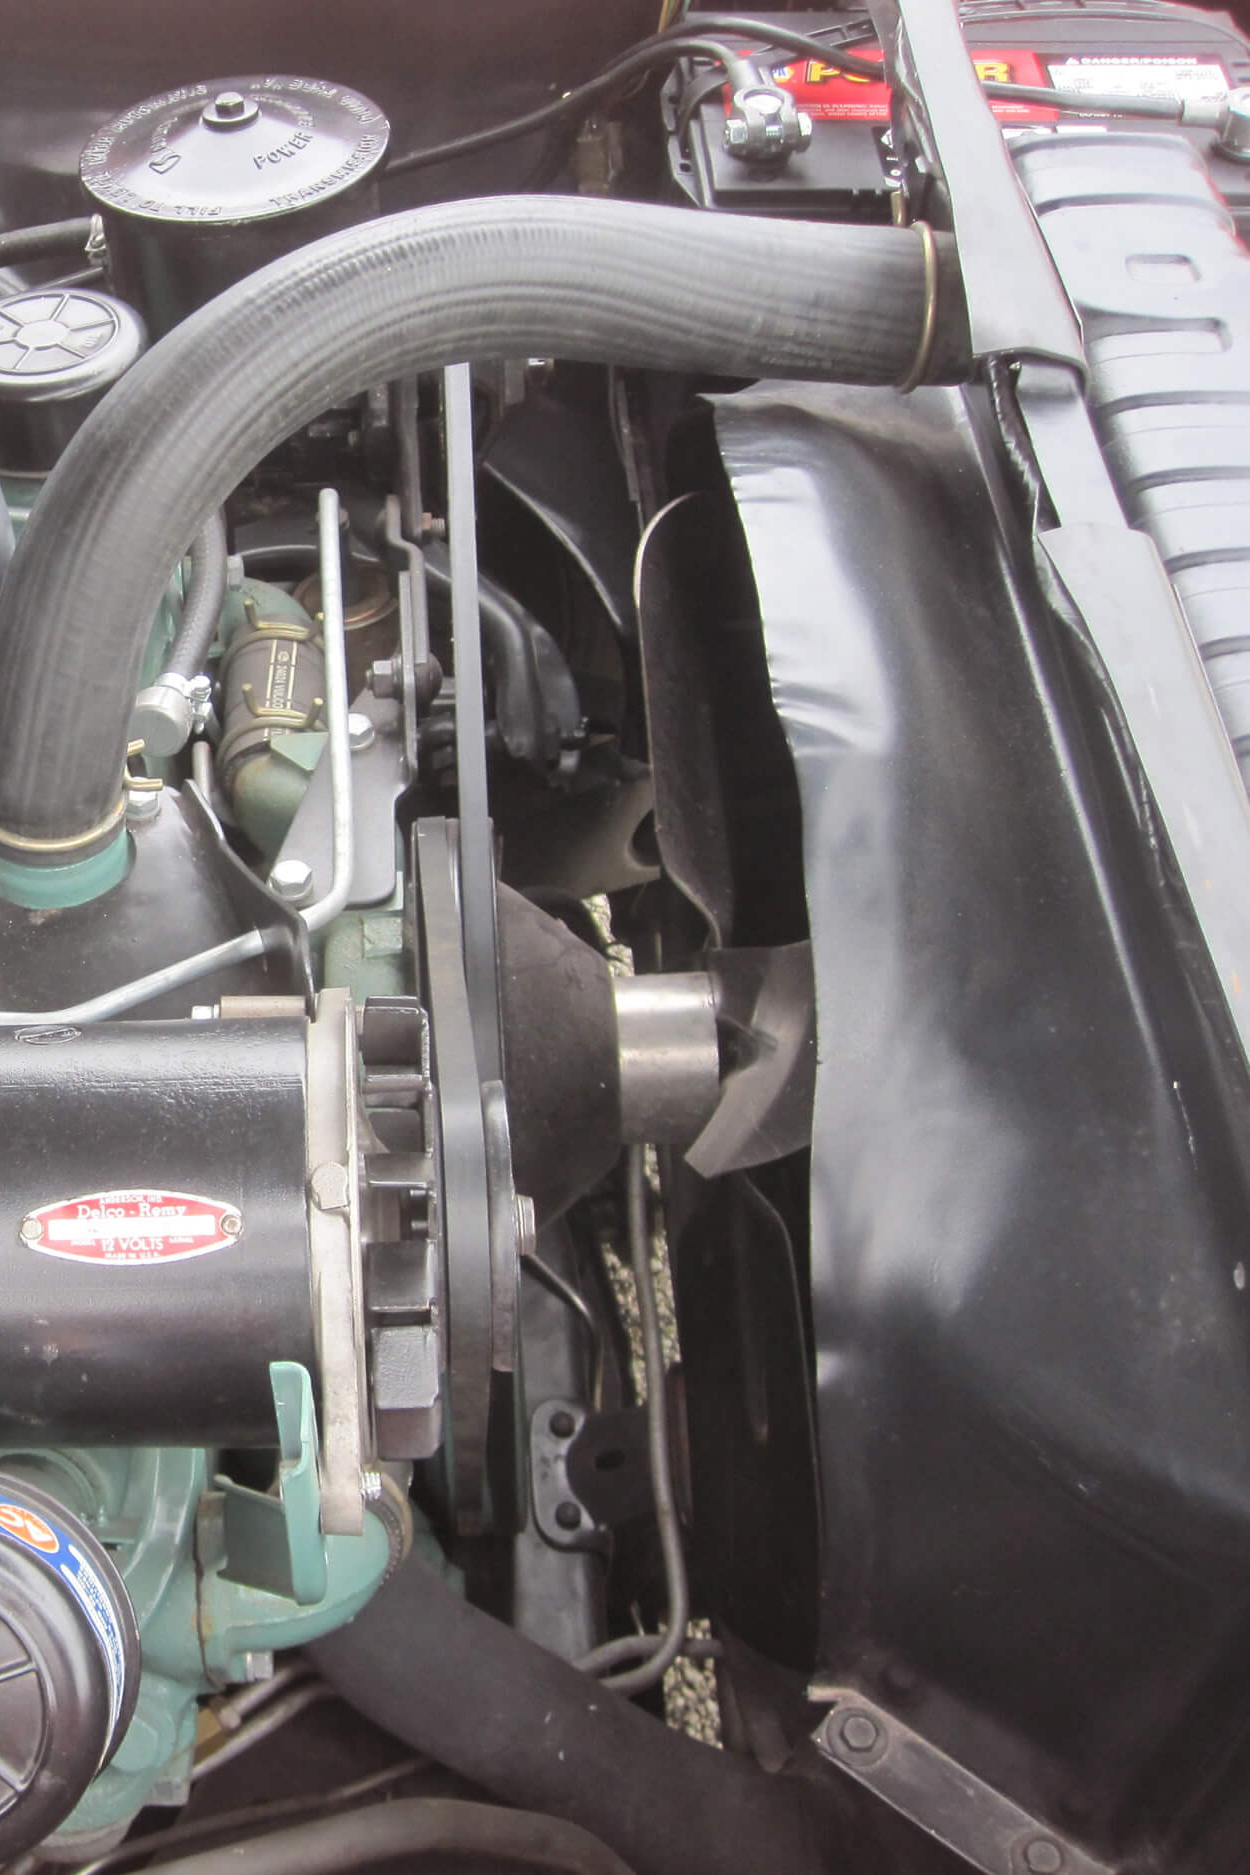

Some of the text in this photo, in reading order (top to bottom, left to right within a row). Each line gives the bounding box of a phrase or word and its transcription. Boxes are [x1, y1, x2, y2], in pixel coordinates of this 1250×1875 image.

[1081, 57, 1198, 65] DANGER/POISON
[253, 130, 314, 170] POWER
[269, 133, 379, 208] TRANSMISSION
[77, 1204, 125, 1219] Delco
[138, 1203, 187, 1218] Remy
[102, 1237, 164, 1251] 12 VOLTS
